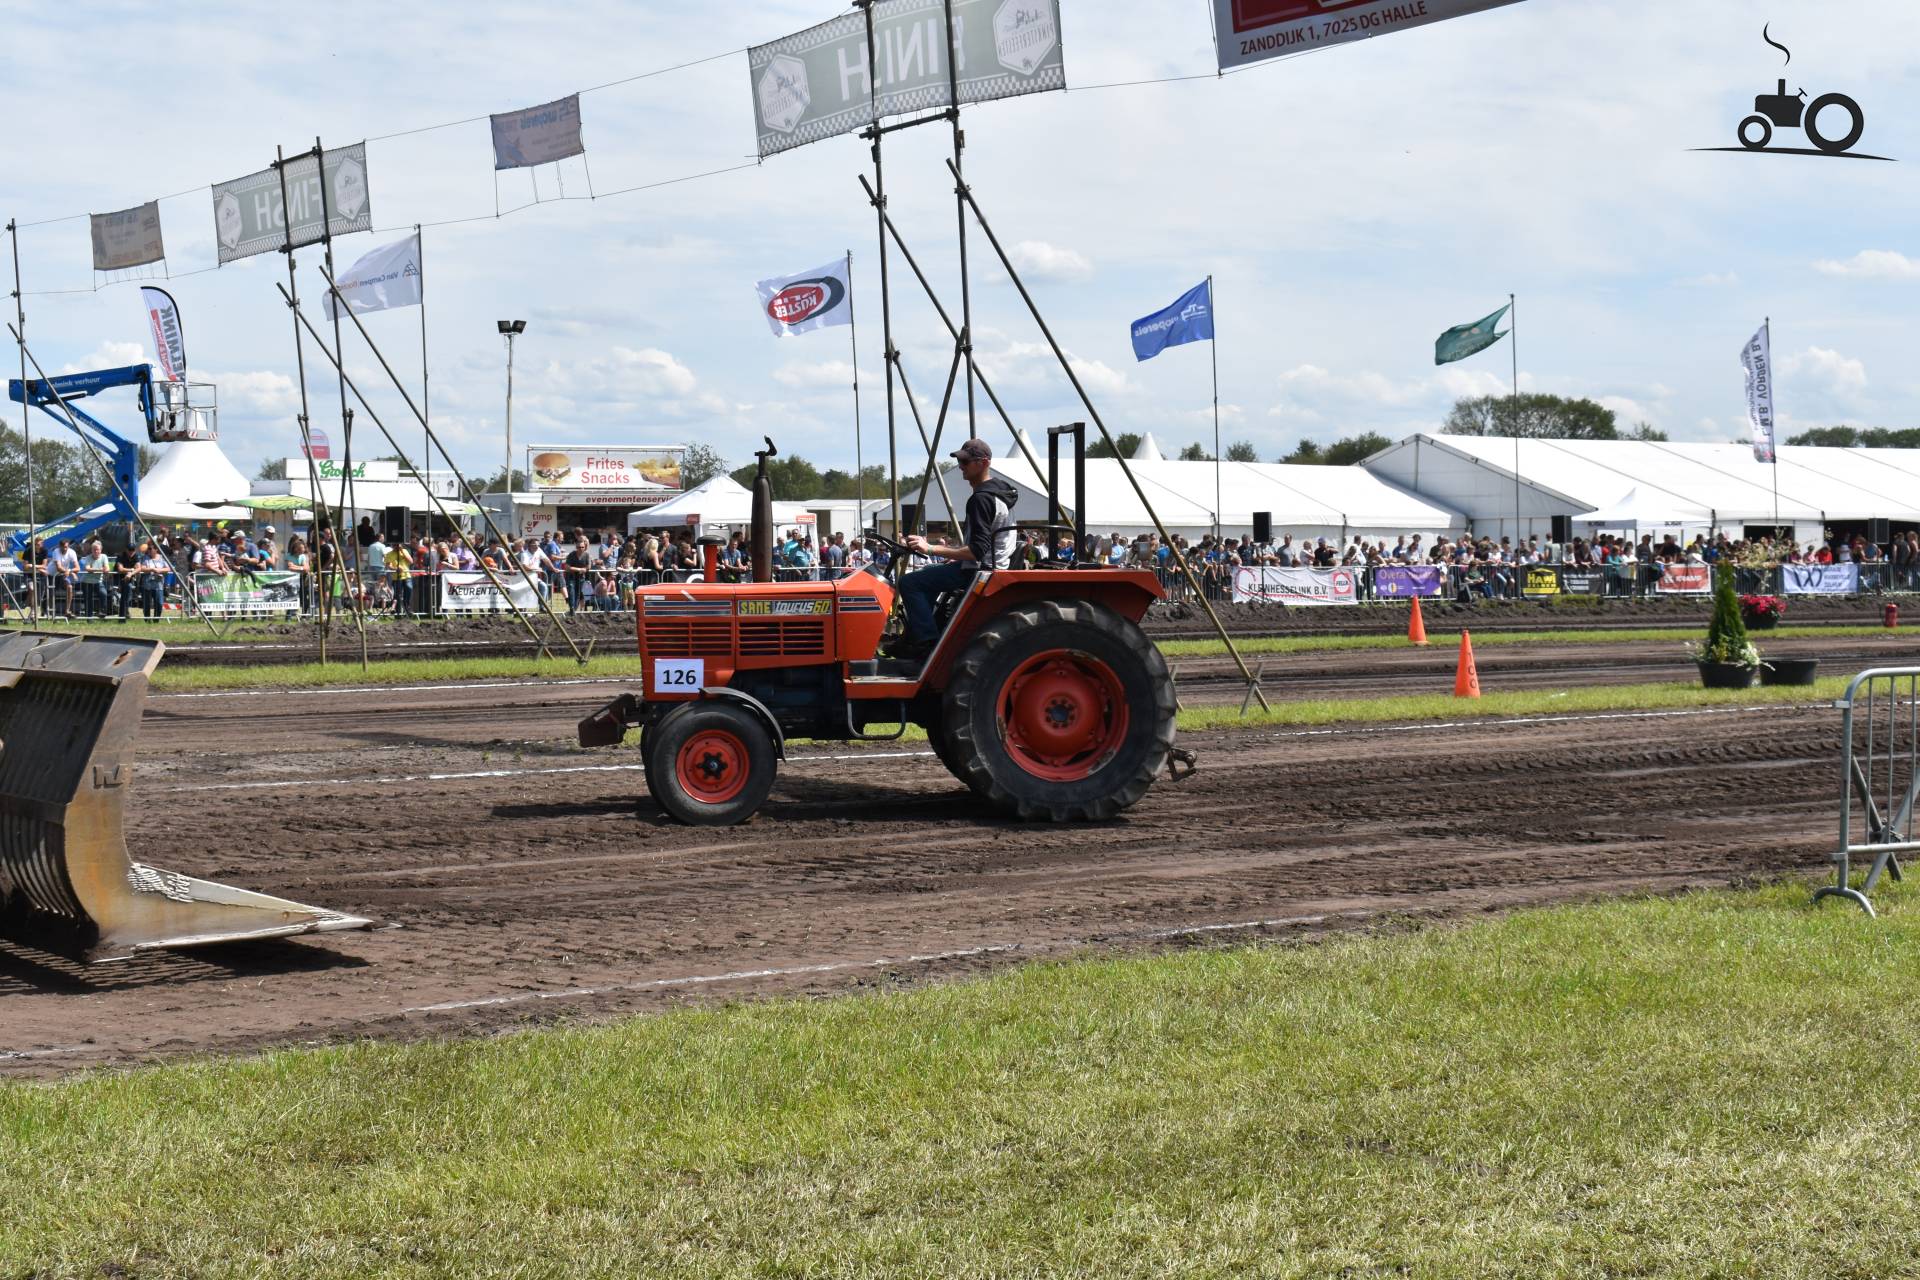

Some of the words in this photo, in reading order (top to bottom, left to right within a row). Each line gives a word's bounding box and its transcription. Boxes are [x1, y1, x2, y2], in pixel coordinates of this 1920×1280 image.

[1240, 28, 1305, 55] ZANDDIJK
[1308, 26, 1320, 40] 1,
[1323, 17, 1358, 37] 7025
[1359, 12, 1380, 29] DG
[1381, 1, 1428, 24] HALLE
[74, 377, 101, 386] verhuur
[319, 459, 366, 478] Groch
[587, 457, 625, 470] Frites
[581, 472, 630, 484] Snacks
[525, 521, 533, 533] de
[532, 511, 553, 523] timp
[1249, 583, 1312, 595] KLENHESSELINK
[1315, 585, 1328, 595] B.V.
[662, 669, 697, 686] 126
